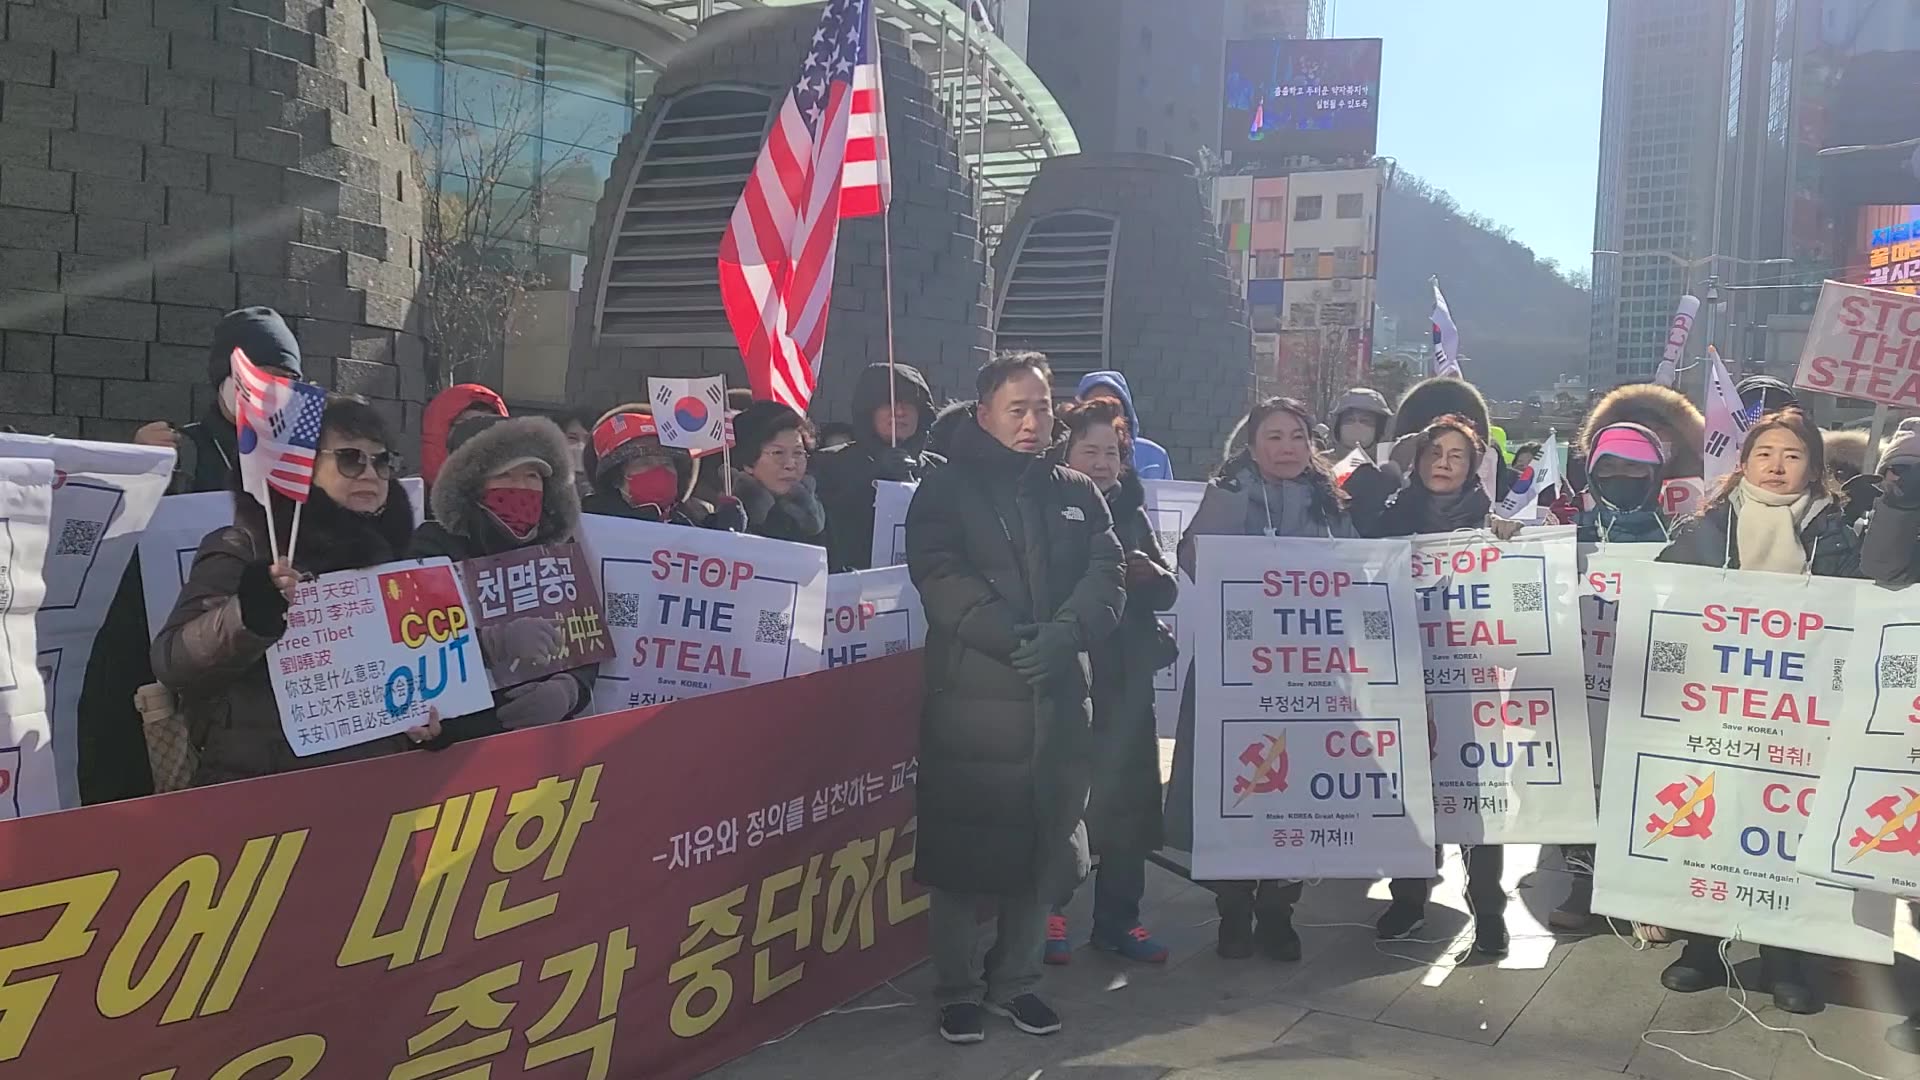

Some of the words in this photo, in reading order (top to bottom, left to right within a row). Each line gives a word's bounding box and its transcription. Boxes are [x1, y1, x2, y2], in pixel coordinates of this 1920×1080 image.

[1807, 355, 1920, 406] STEA
[650, 549, 754, 592] STOP
[1262, 570, 1351, 597] STOP
[322, 576, 370, 601] 天安门
[1415, 583, 1492, 611] THE
[400, 604, 467, 649] CCP
[657, 593, 735, 633] THE
[1273, 608, 1345, 635] THE
[1702, 604, 1824, 641] STOP
[276, 635, 310, 653] Free
[312, 624, 355, 645] Tibet
[1420, 620, 1518, 647] TEAL
[632, 636, 751, 679] STEAL
[1252, 646, 1369, 674] STEAL
[1712, 644, 1806, 682] THE
[383, 634, 470, 715] OUT
[1424, 667, 1467, 685] 정선거
[1259, 695, 1320, 713] 부정선거
[1473, 700, 1550, 728] CCP
[1681, 682, 1831, 727] STEAL
[1722, 722, 1743, 732] Save
[1325, 730, 1396, 758] CCP
[1460, 741, 1554, 768] OUT!
[1686, 734, 1761, 762] 부정선거
[1767, 743, 1812, 767] 멈춰!
[1310, 772, 1398, 800] OUT!
[746, 795, 804, 848] 정의를
[811, 771, 884, 824] 실천하는
[1463, 795, 1508, 814] 꺼져!!
[1762, 783, 1817, 818] CC
[1272, 828, 1305, 848] 중공
[1310, 827, 1354, 848] 꺼져!!
[1740, 825, 1804, 862] OU
[335, 763, 605, 970] 대한
[1683, 859, 1706, 869] Make
[1710, 863, 1741, 874] KOREA
[1743, 868, 1767, 879] Great
[1689, 877, 1729, 902] 중공
[1735, 884, 1790, 911] 꺼져!!
[1891, 877, 1917, 888] Make
